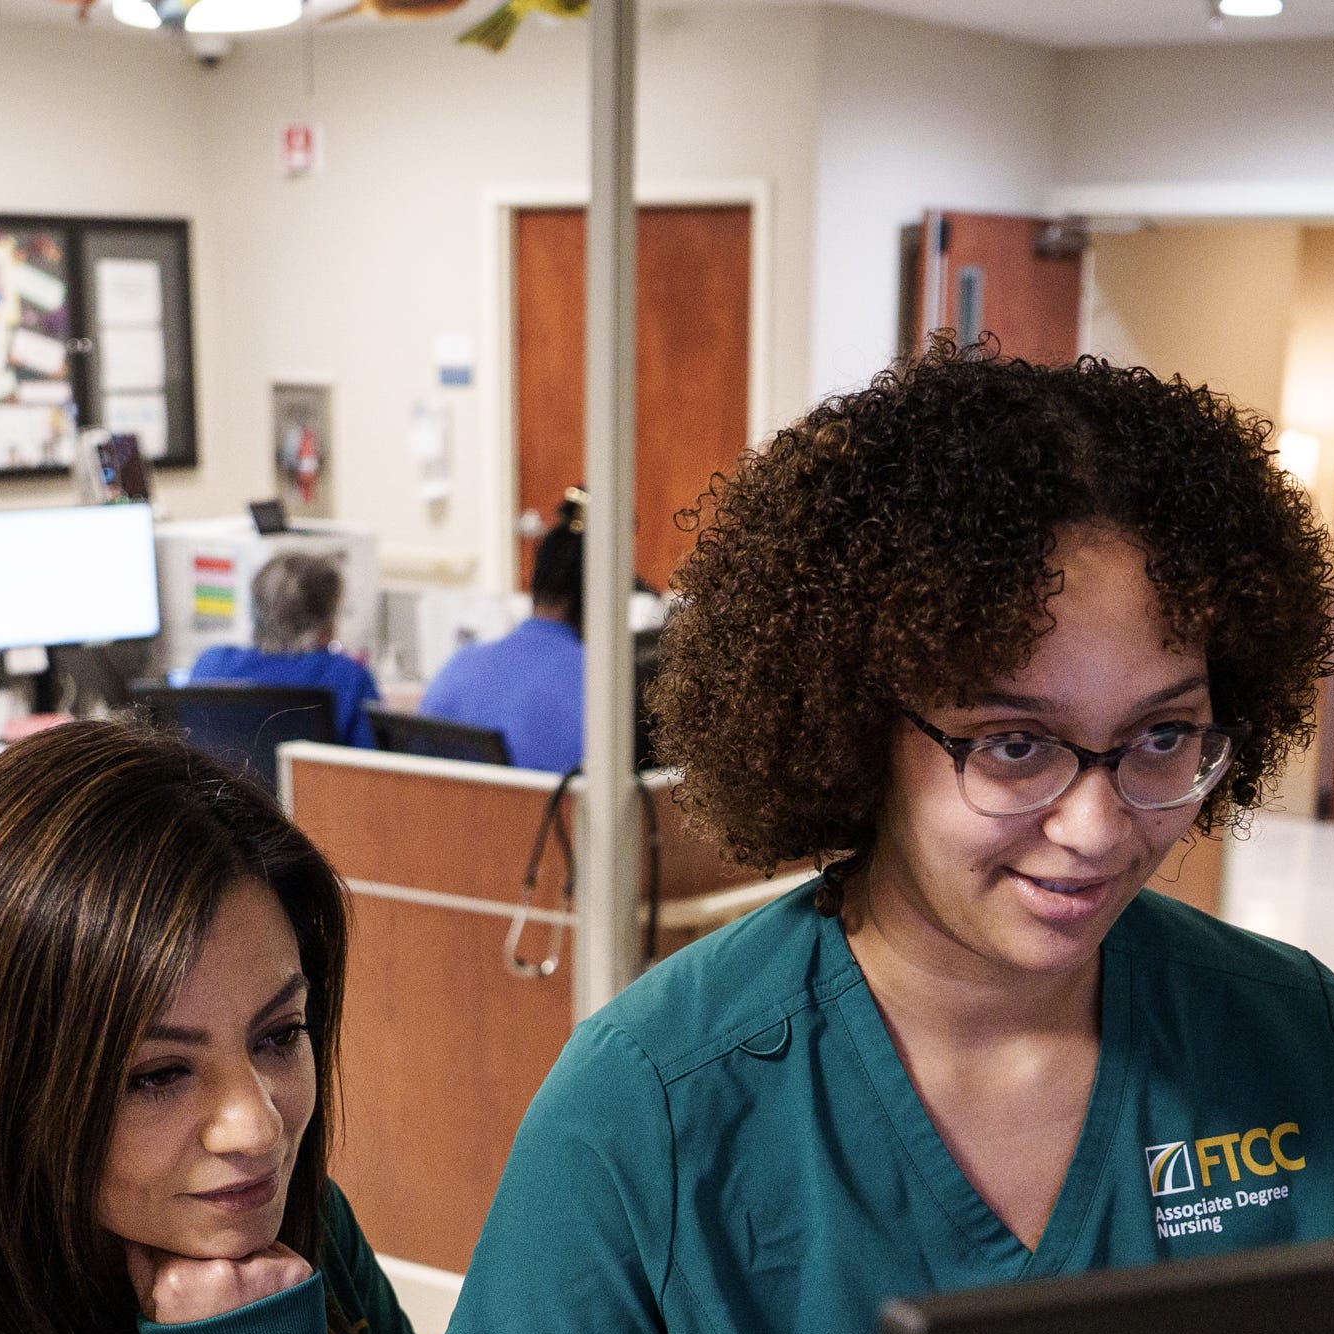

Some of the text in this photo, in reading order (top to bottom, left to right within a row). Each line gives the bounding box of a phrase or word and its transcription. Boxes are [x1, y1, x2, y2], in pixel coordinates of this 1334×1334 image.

[1195, 1122, 1306, 1187] FTCC
[1155, 1185, 1289, 1223] Associate Degree
[1157, 1215, 1223, 1239] Nursing
